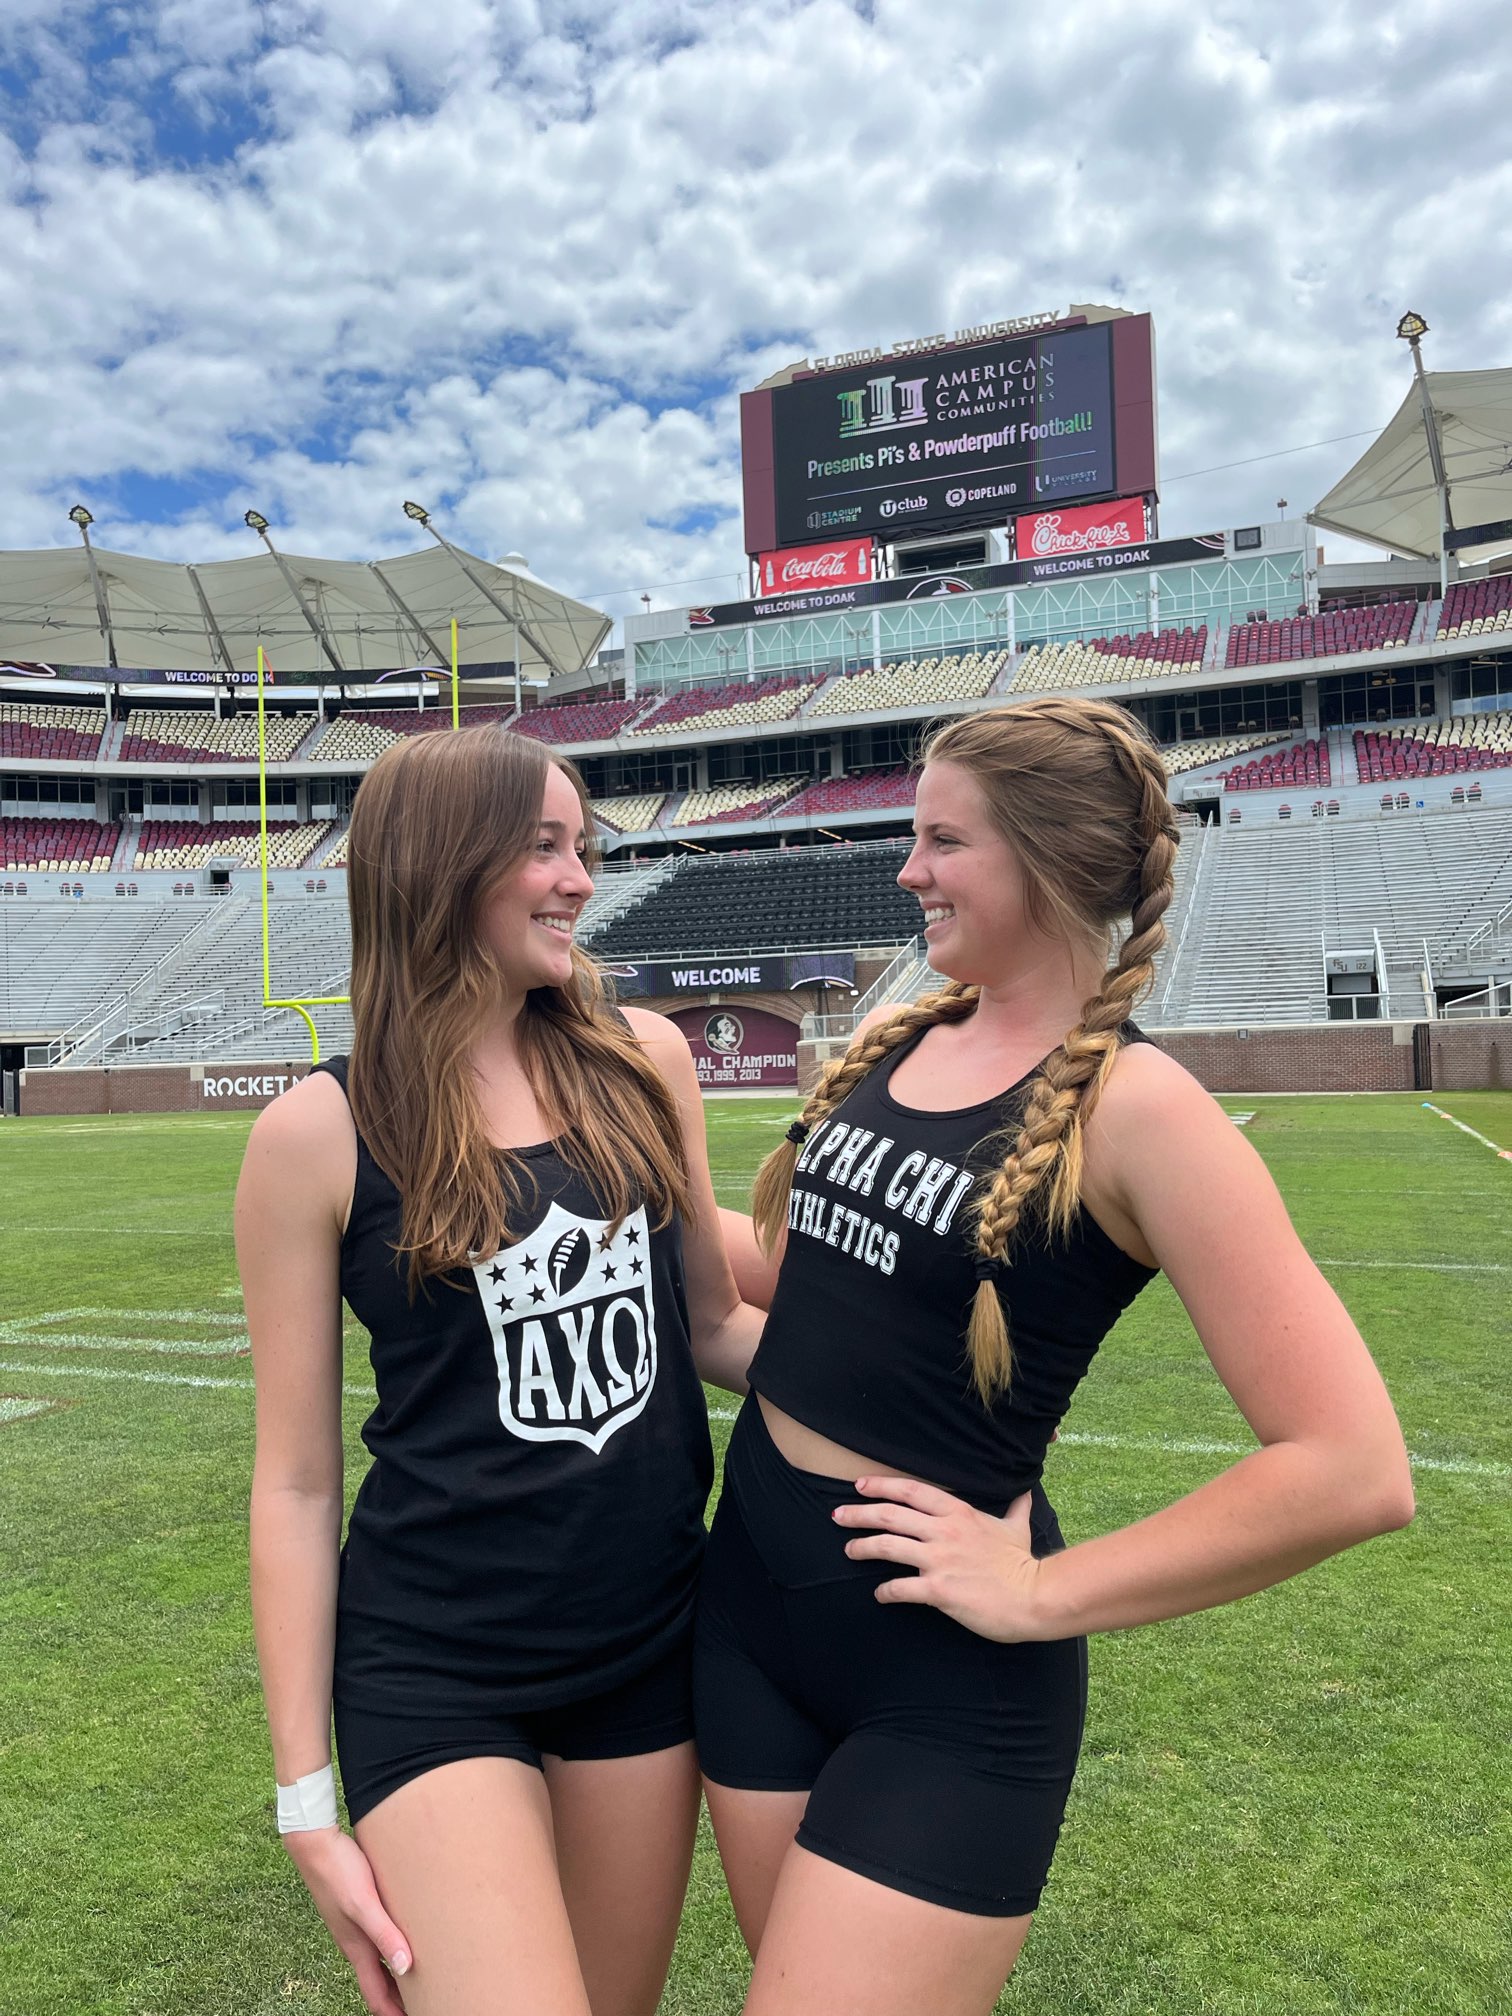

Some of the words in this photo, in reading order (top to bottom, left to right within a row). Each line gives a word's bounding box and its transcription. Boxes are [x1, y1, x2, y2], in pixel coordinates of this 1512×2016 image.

[813, 346, 883, 374] FLORIDA
[892, 333, 946, 358] STATE
[954, 310, 1060, 346] UNIVERSITY
[936, 353, 1054, 389] AMERICAN
[936, 372, 1054, 407] CAMPUS
[936, 391, 1055, 421] COMMUNITIES
[807, 452, 874, 479] Presents
[908, 442, 921, 461] &
[924, 425, 1017, 459] Powderpuff
[1020, 411, 1093, 442] Football!
[968, 483, 1017, 501] COPELAND
[821, 514, 858, 526] CENTRE
[1031, 514, 1130, 555] Chick-fil-A
[782, 551, 848, 582] Coca-Cola
[1033, 558, 1095, 576] WELCOME
[1096, 554, 1114, 567] TO
[1115, 549, 1150, 565] DOAK
[753, 599, 807, 615] WELCOME
[808, 597, 823, 608] TO
[824, 591, 855, 606] DOAK
[165, 671, 223, 683] WELCOME
[224, 672, 240, 683] TO
[241, 672, 274, 684] DOK
[671, 966, 762, 987] WELCOME
[722, 1054, 796, 1069] CHAMPION
[740, 1068, 761, 1080] 2013
[203, 1075, 288, 1097] ROCKET
[796, 1120, 895, 1197] LPHA
[884, 1150, 975, 1236] CHI
